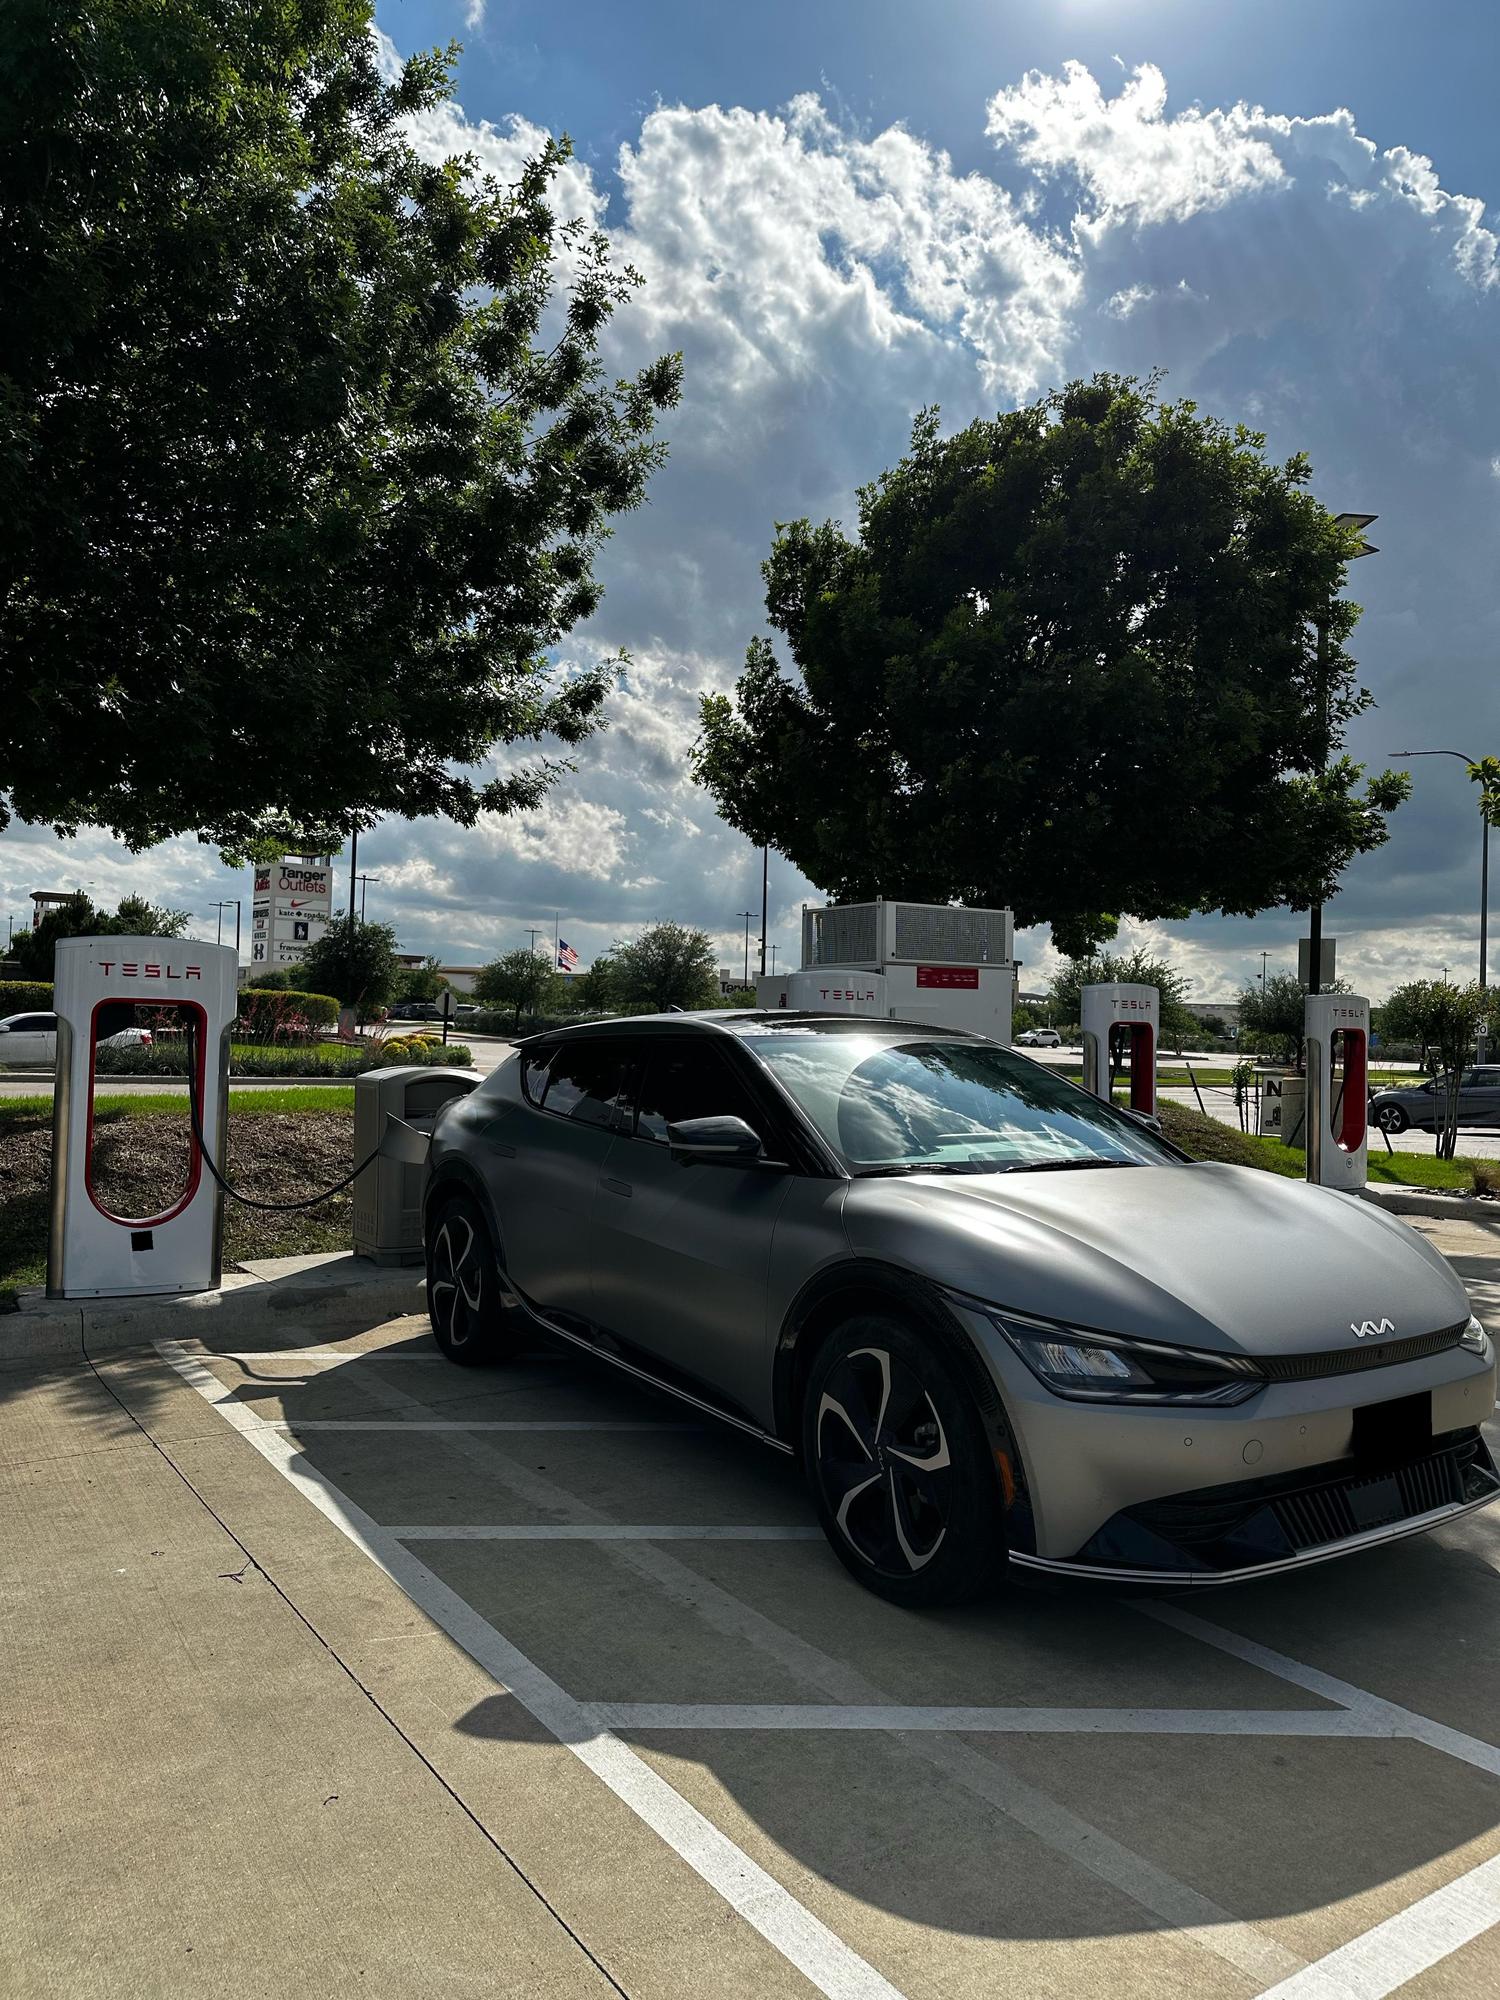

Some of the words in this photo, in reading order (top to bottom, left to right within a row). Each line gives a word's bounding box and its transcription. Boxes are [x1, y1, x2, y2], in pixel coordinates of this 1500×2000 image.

[280, 866, 327, 882] Tanger
[278, 877, 326, 894] Outlets
[279, 909, 295, 917] kate
[98, 962, 201, 980] TESLA
[819, 989, 875, 1001] TESLA
[1111, 999, 1152, 1010] TESLA
[1332, 1008, 1365, 1018] TESLA
[1350, 1317, 1395, 1338] KIA
